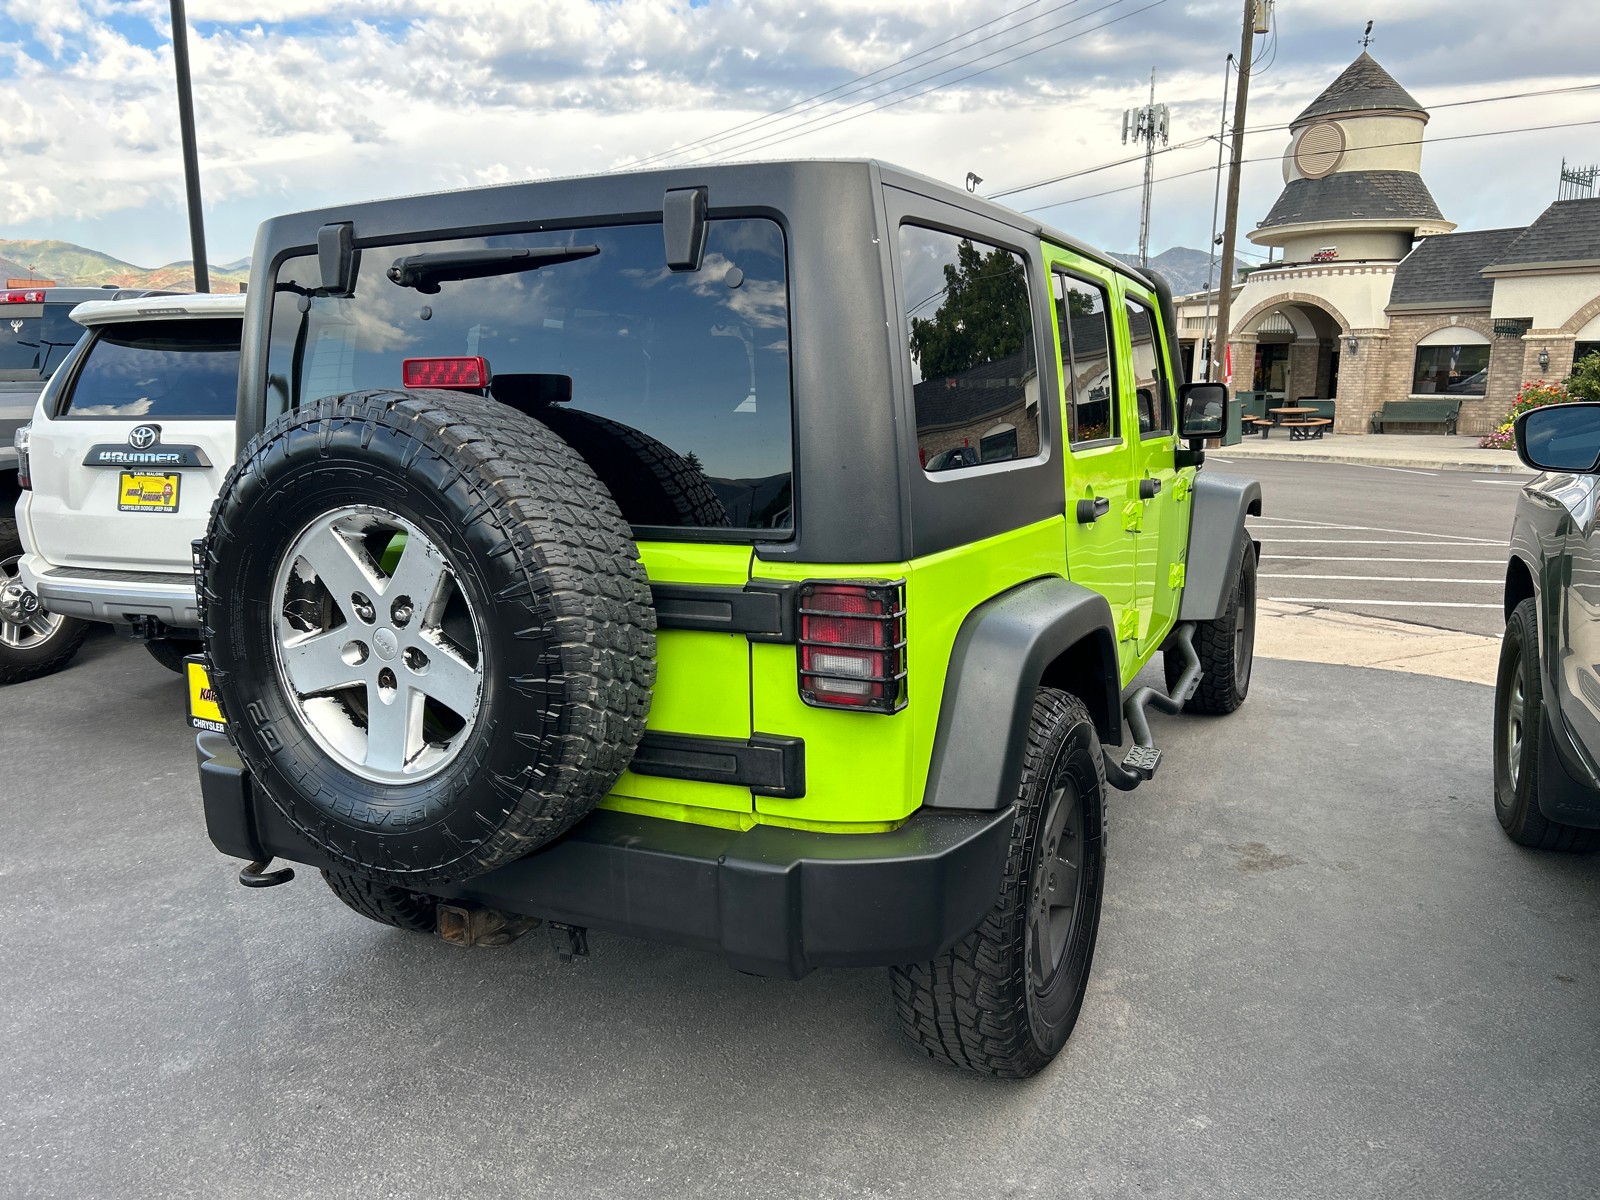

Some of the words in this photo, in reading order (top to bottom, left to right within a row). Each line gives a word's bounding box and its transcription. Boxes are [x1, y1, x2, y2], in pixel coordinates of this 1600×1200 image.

[99, 451, 180, 464] 4RUNNER
[266, 466, 410, 513] NITTO
[200, 687, 218, 703] KAR
[193, 718, 225, 732] CHRYSLER
[287, 758, 426, 827] GRAPPLER
